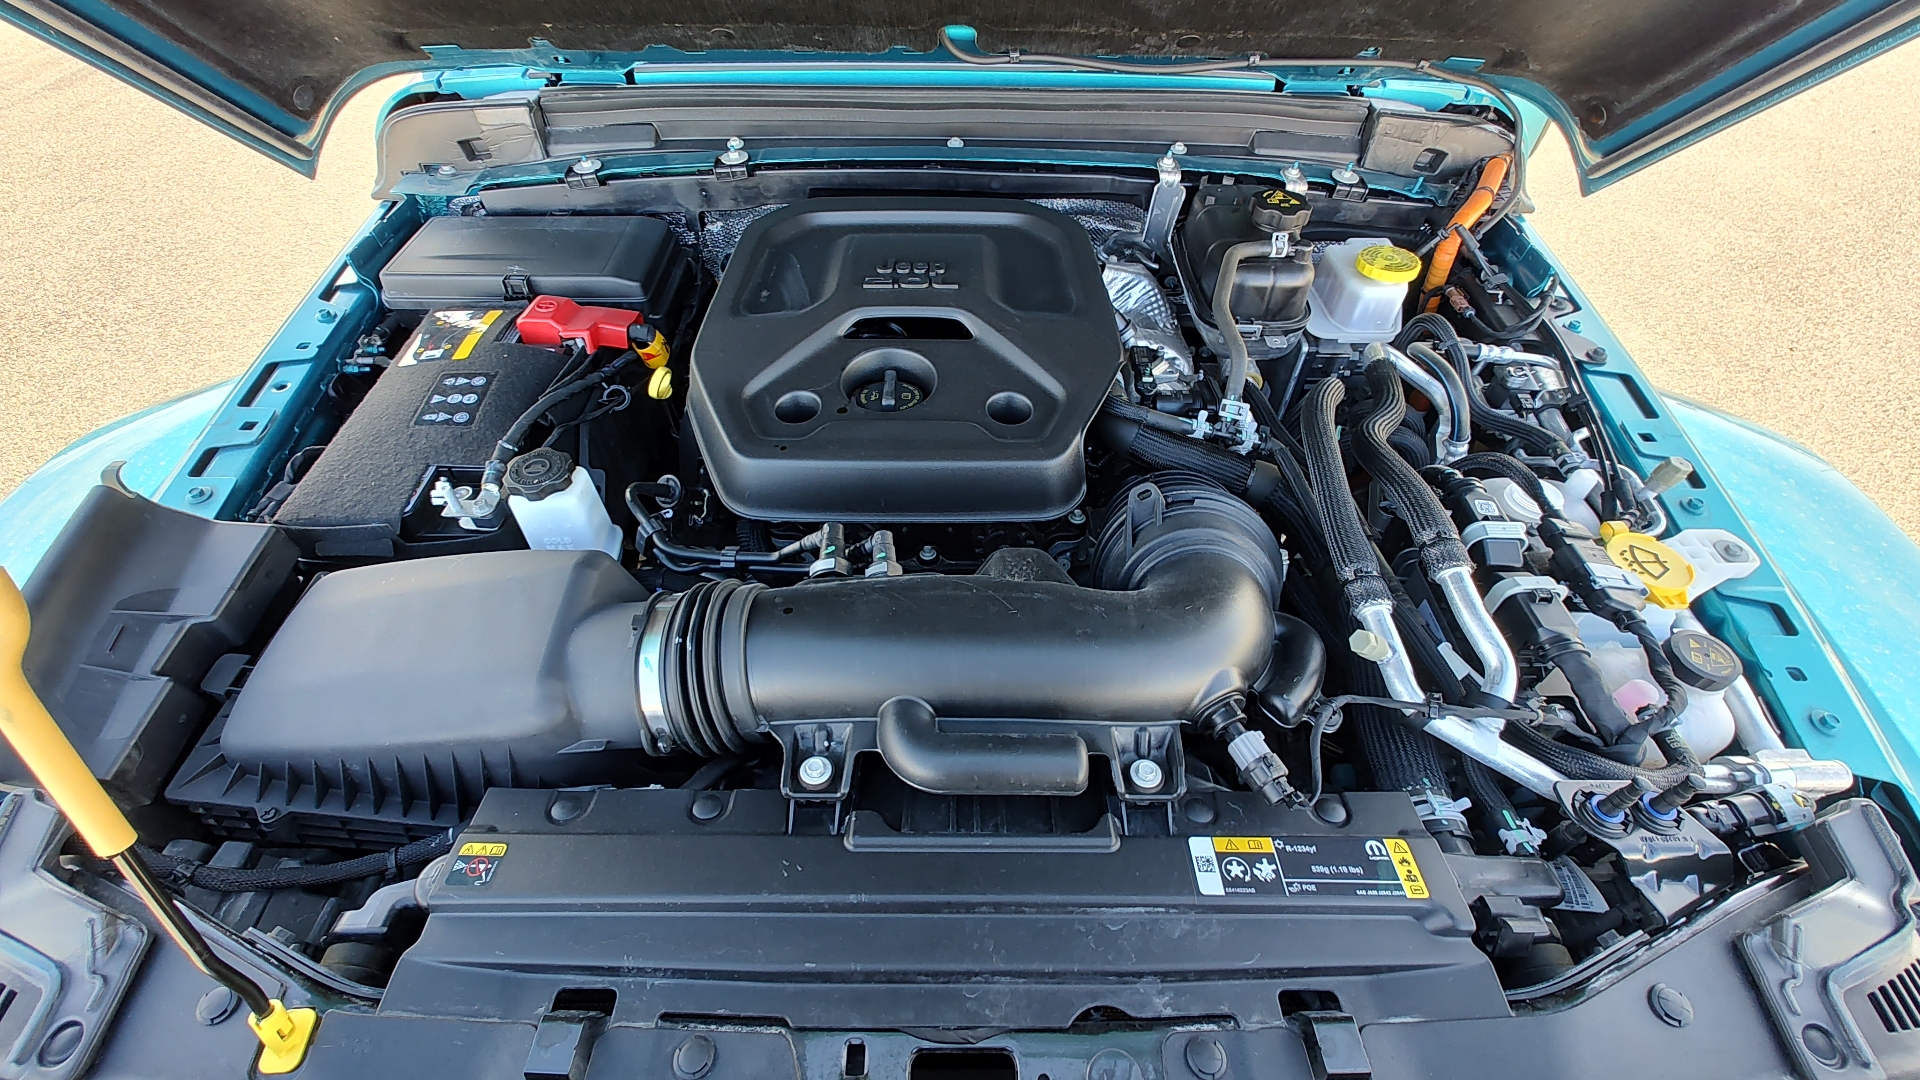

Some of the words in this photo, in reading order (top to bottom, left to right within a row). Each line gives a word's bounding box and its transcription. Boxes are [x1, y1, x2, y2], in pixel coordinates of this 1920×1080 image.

[876, 259, 946, 276] Jeep
[863, 277, 959, 289] 2.0L
[1302, 884, 1317, 892] POE
